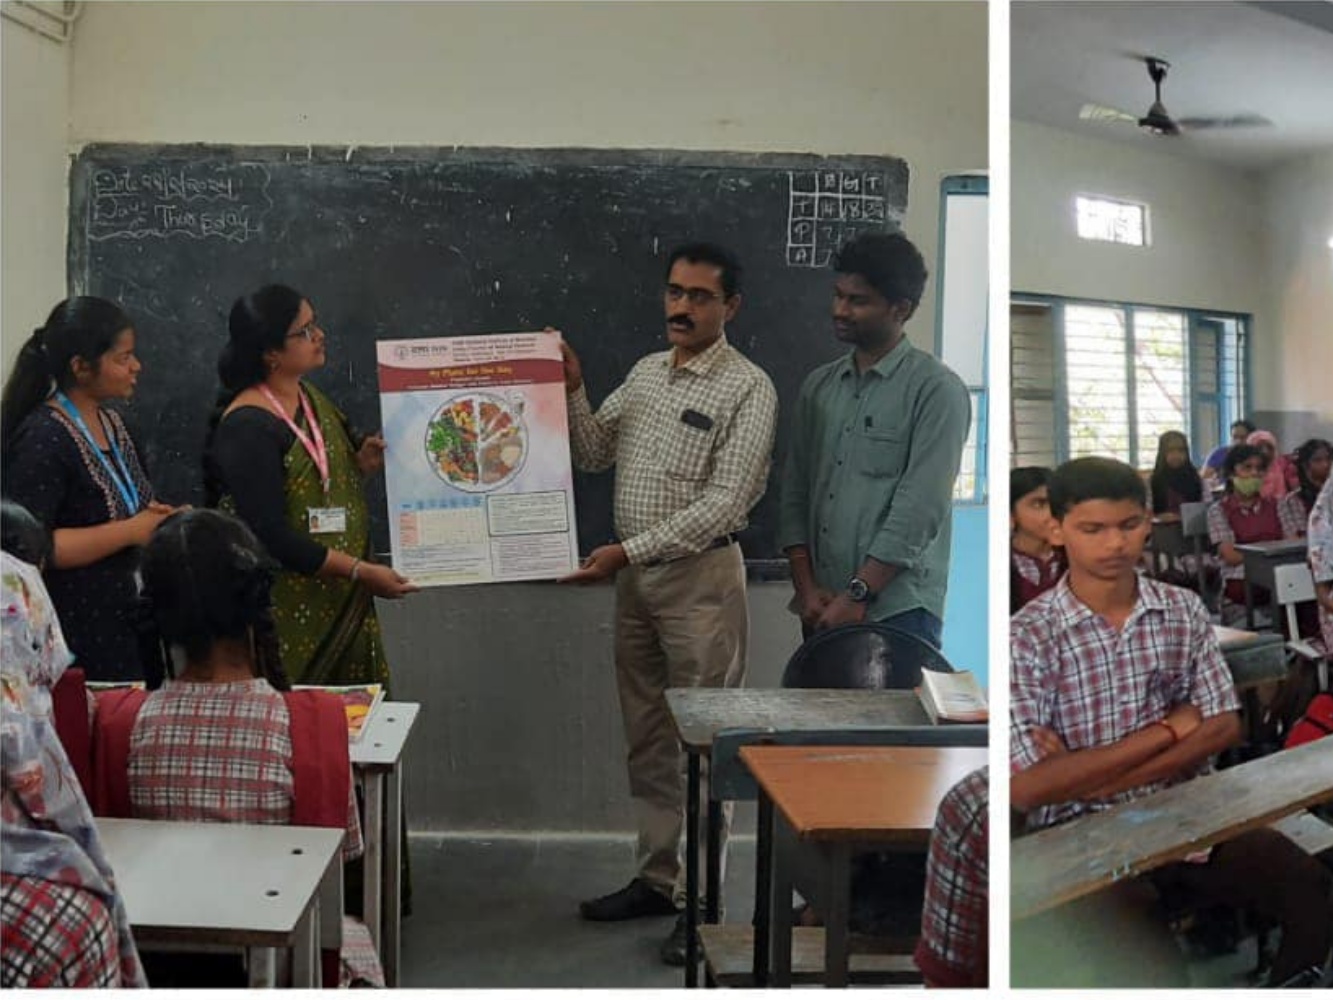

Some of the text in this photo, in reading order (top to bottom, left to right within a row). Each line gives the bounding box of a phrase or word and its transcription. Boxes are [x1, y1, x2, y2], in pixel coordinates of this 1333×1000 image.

[866, 176, 880, 190] T
[794, 201, 810, 214] T
[794, 222, 811, 241] P
